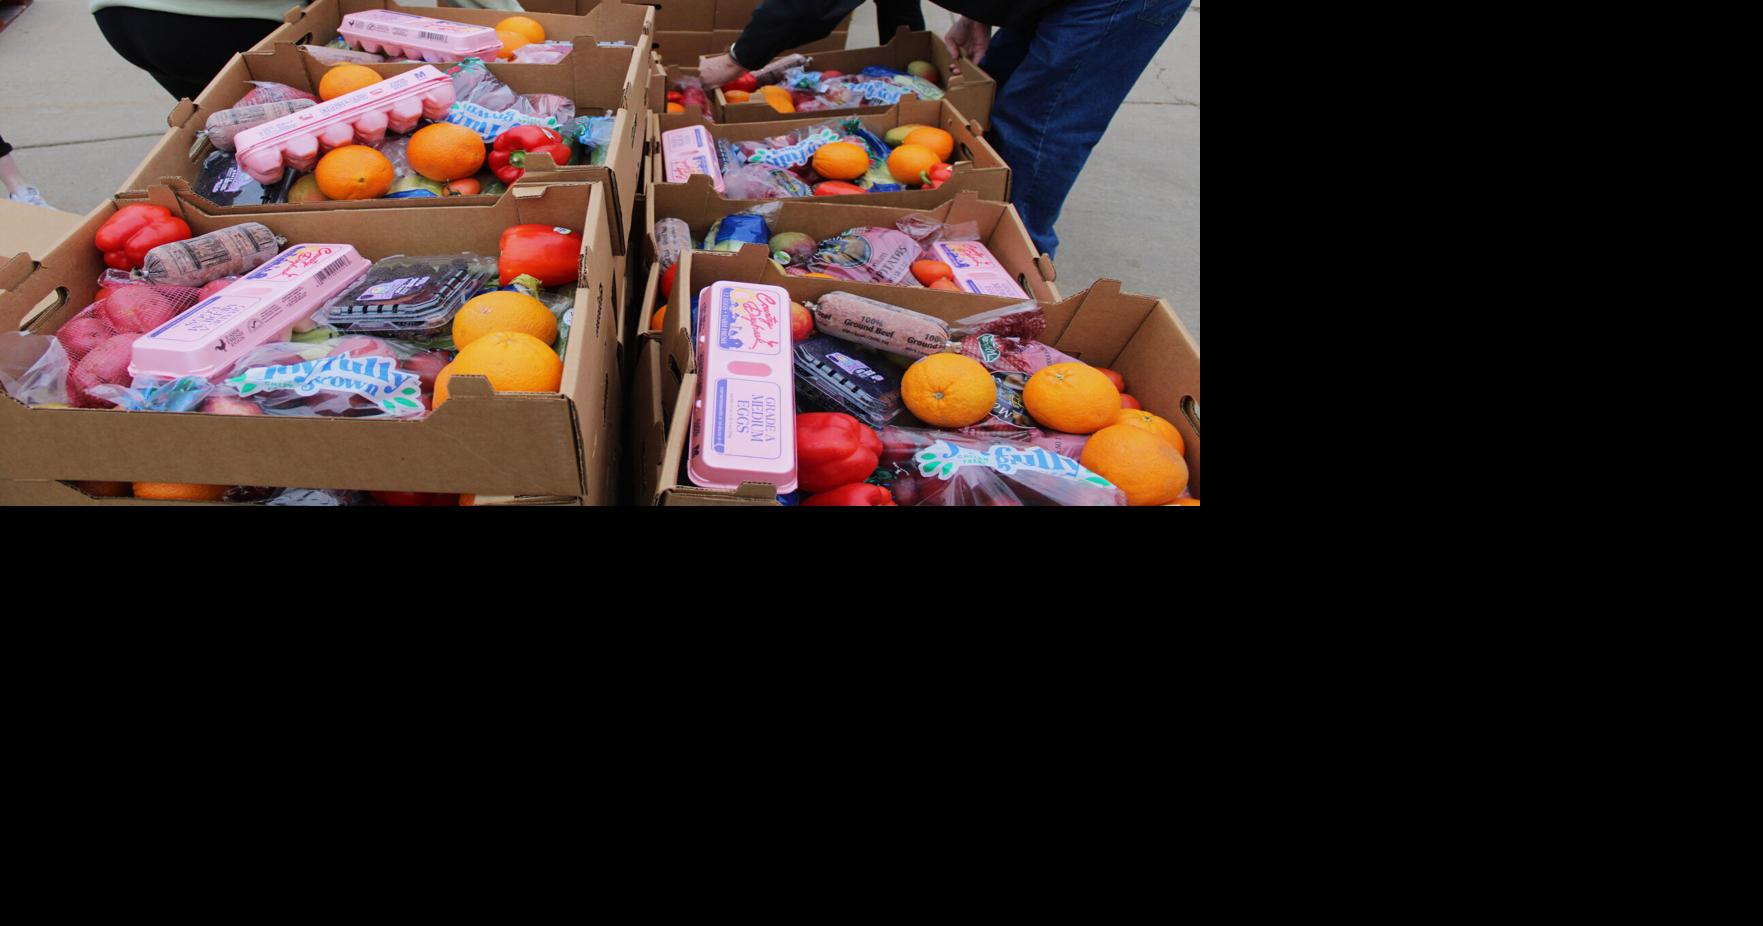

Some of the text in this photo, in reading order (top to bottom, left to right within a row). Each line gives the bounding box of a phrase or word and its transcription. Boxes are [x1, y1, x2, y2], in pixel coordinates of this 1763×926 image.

[844, 318, 874, 335] Ground
[876, 324, 895, 339] Beef
[860, 315, 883, 327] 100%
[907, 336, 938, 350] Ground
[737, 399, 749, 434] EGGS
[751, 394, 763, 442] MEDIUM
[765, 397, 776, 434] GRADE
